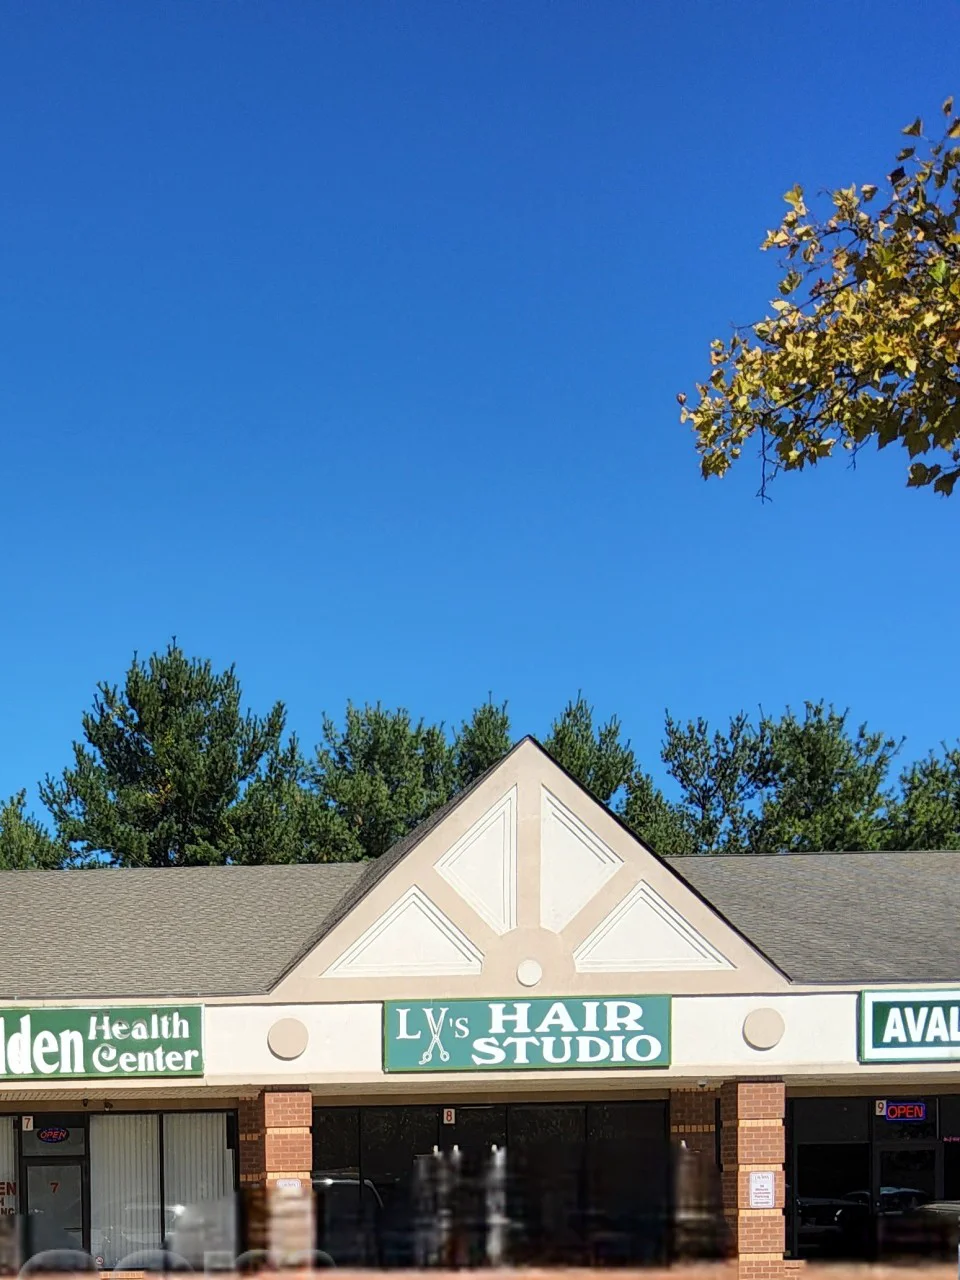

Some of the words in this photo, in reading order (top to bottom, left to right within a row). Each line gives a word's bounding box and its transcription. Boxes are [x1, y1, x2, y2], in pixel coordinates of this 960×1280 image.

[487, 1000, 645, 1035] HAIR
[87, 1010, 191, 1041] Health
[470, 1034, 663, 1066] STUDIO
[91, 1042, 200, 1074] Center
[877, 1101, 885, 1114] 9
[887, 1105, 924, 1119] OPEN
[23, 1117, 32, 1129] 7
[445, 1109, 454, 1123] 8
[39, 1130, 69, 1140] OPEN
[49, 1182, 59, 1194] 7
